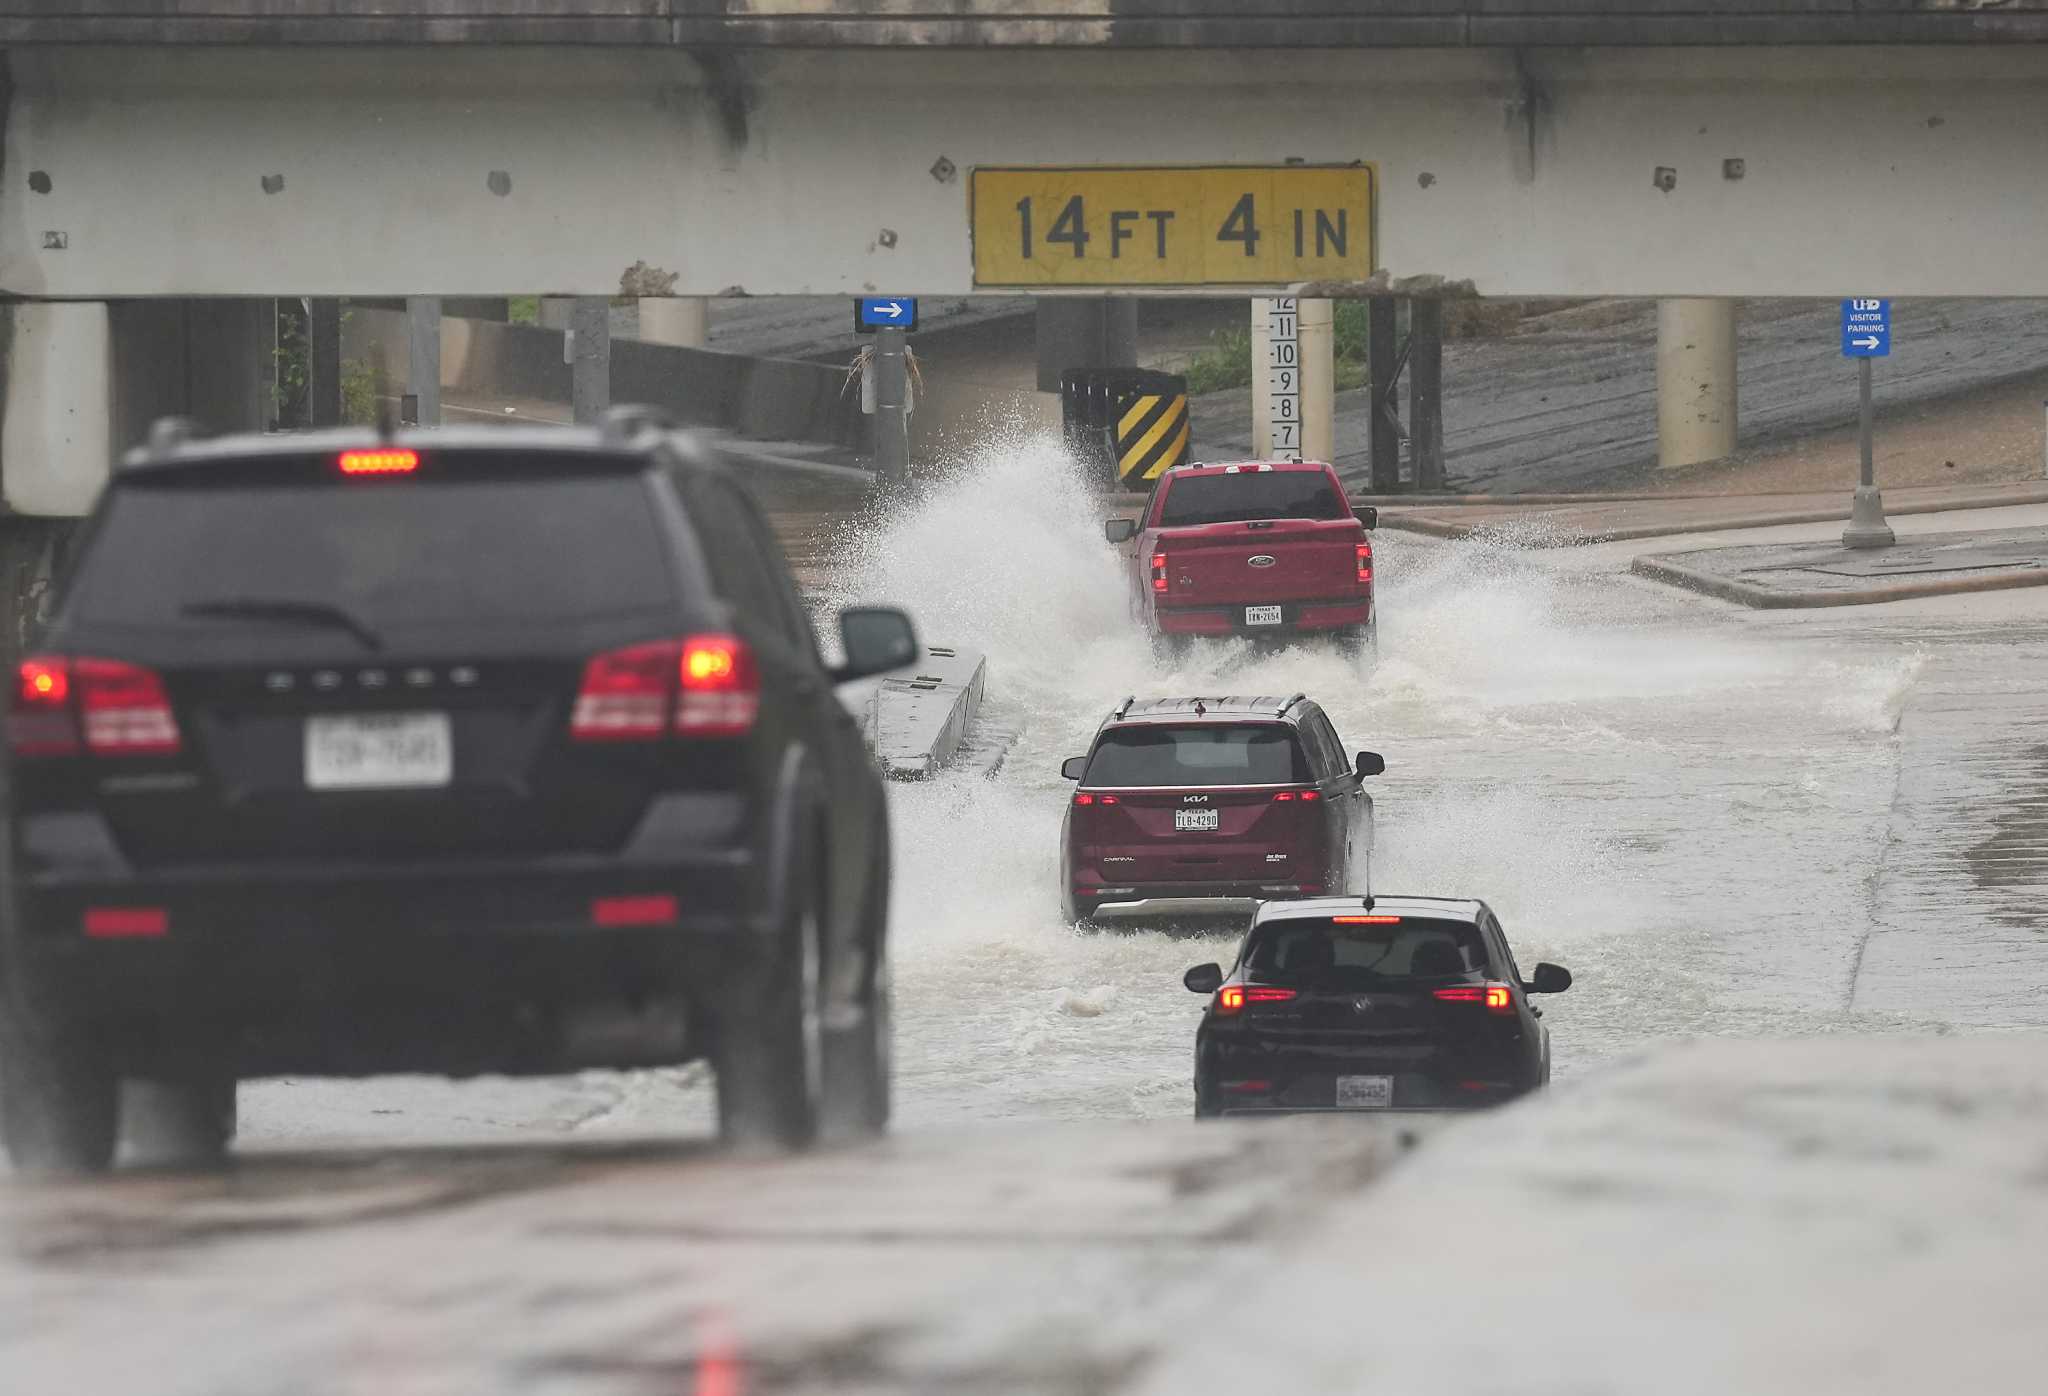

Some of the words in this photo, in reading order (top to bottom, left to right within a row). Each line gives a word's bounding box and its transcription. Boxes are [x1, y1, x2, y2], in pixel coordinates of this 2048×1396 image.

[1016, 195, 1090, 259] 14
[1111, 210, 1175, 259] FT
[1216, 193, 1260, 257] 4
[1294, 208, 1347, 258] IN
[1279, 317, 1291, 336] 11
[1850, 313, 1881, 321] VISITOR
[1847, 324, 1885, 332] PARKING
[1277, 344, 1294, 364] 10
[1280, 371, 1291, 390] 9
[1281, 398, 1292, 418] 8
[1282, 426, 1293, 445] 7
